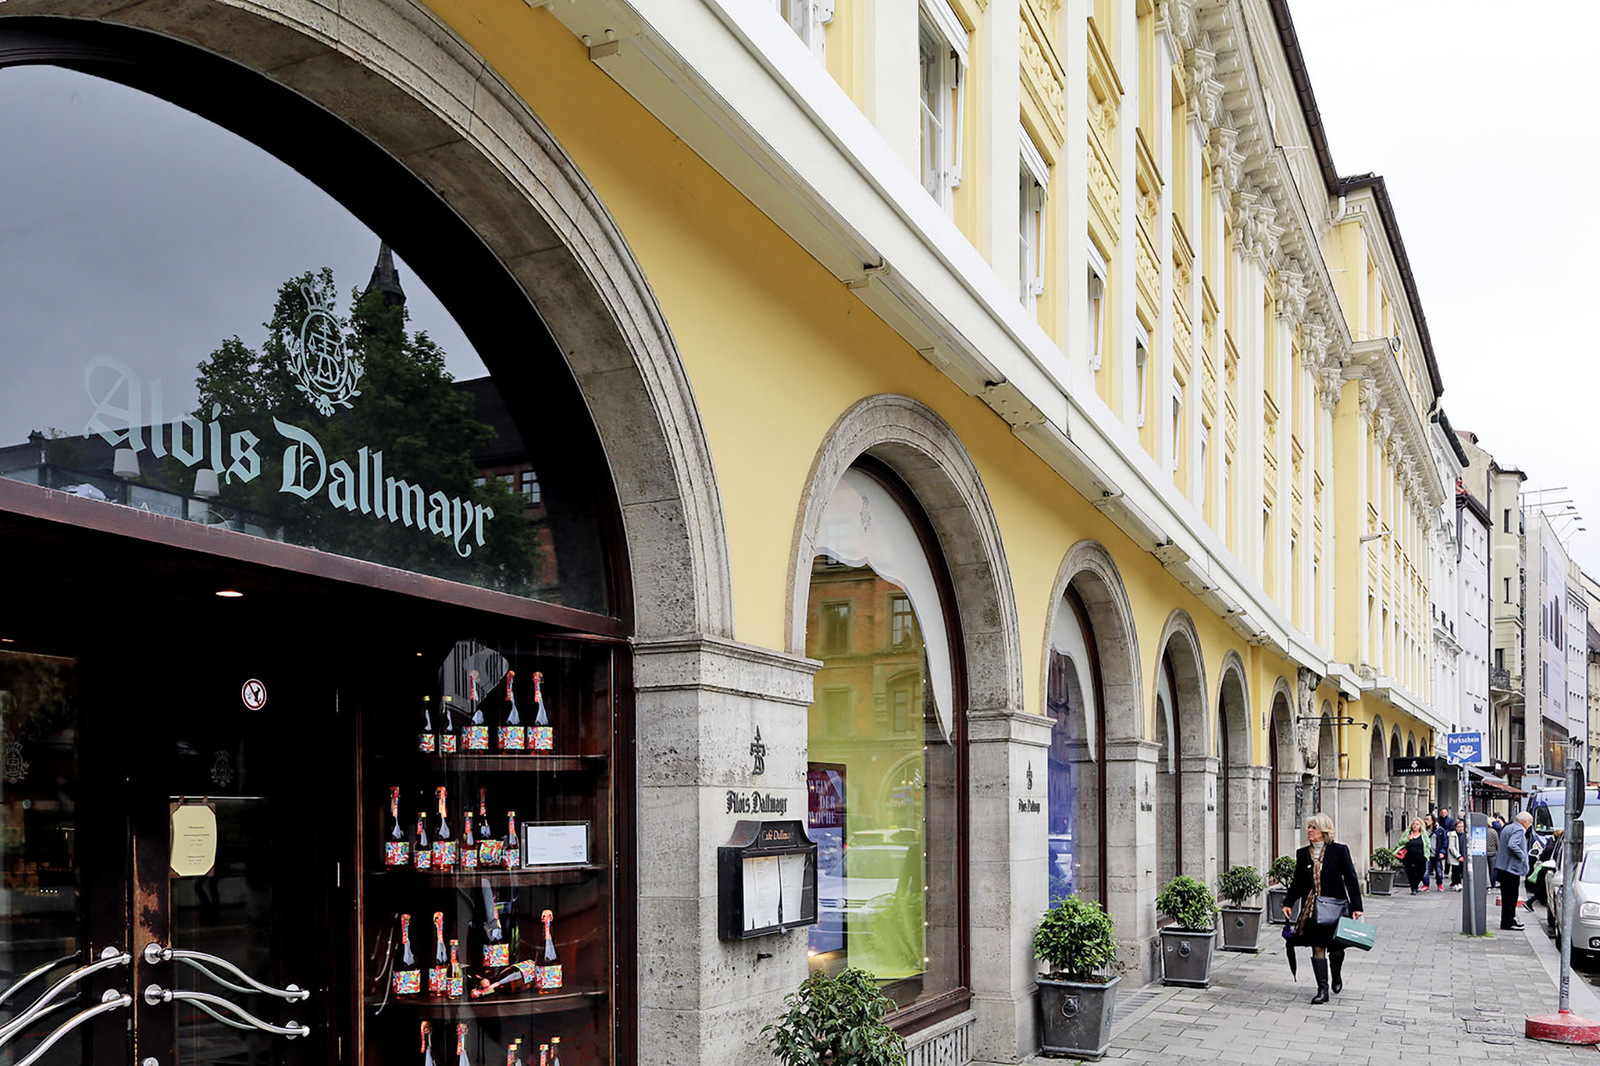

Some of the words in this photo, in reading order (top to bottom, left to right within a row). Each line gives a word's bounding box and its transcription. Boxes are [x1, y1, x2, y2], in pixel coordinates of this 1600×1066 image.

[83, 355, 262, 484] Alois
[272, 415, 495, 558] Dallmayr
[808, 779, 829, 794] WEIN
[726, 789, 750, 815] Alois
[750, 790, 788, 816] Dallmayr
[819, 795, 836, 810] DER
[808, 811, 837, 825] WOCHE
